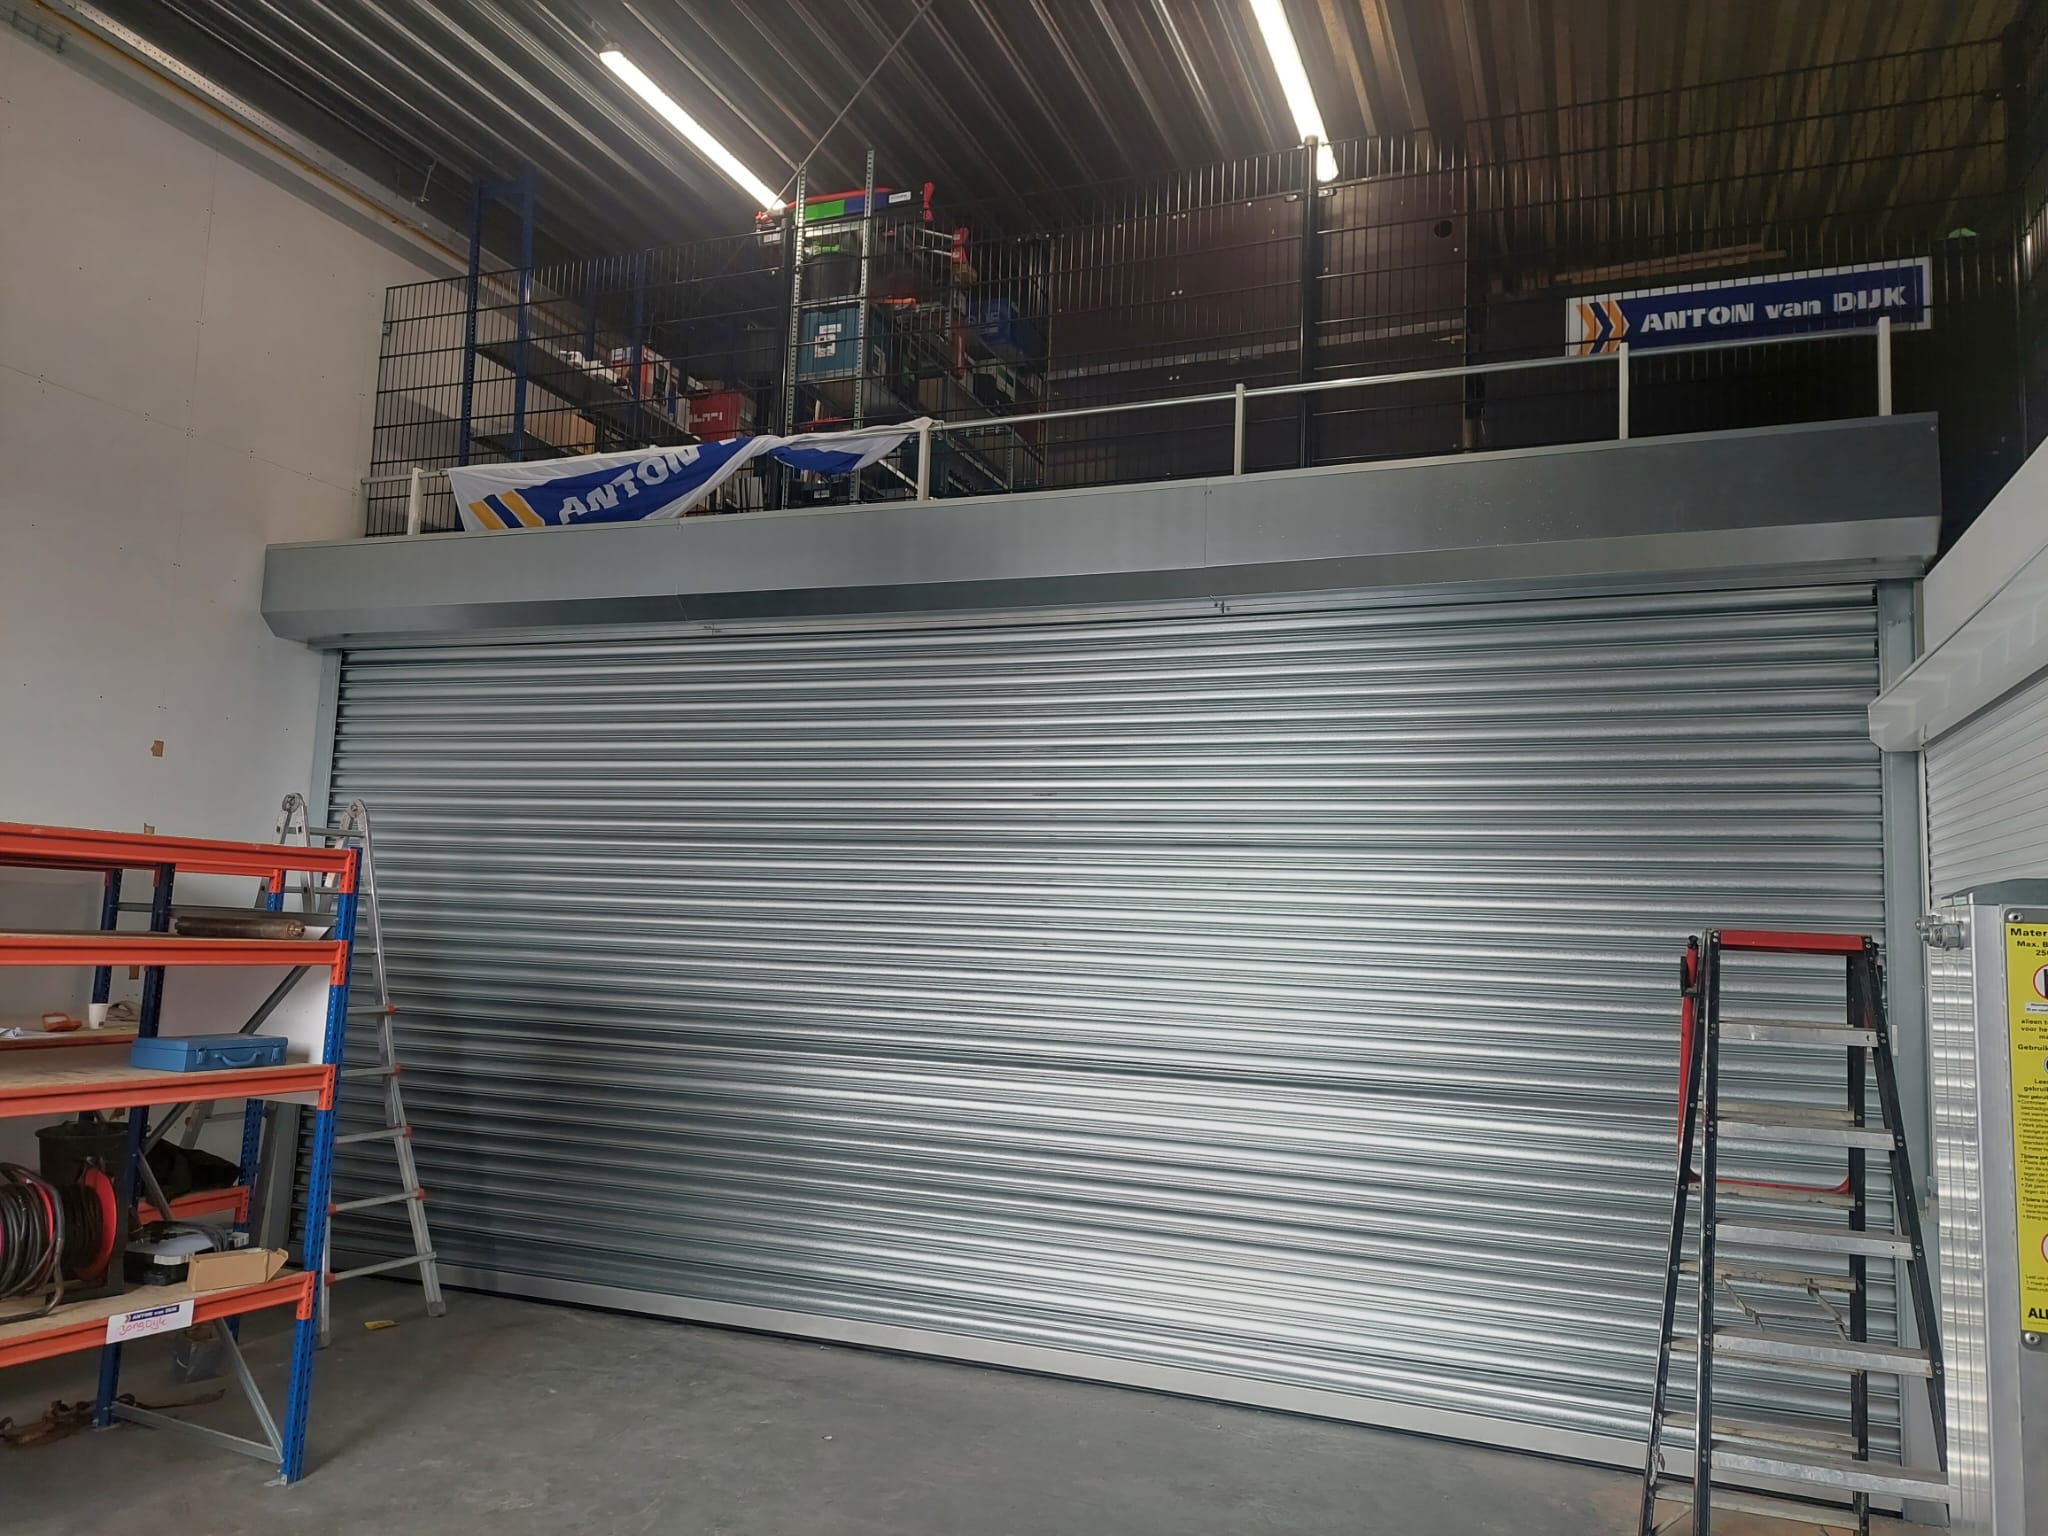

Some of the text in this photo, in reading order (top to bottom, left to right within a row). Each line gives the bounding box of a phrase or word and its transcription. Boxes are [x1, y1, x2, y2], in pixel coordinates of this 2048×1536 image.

[1640, 285, 1907, 333] ANTON van DIJK
[558, 446, 701, 525] ANTON
